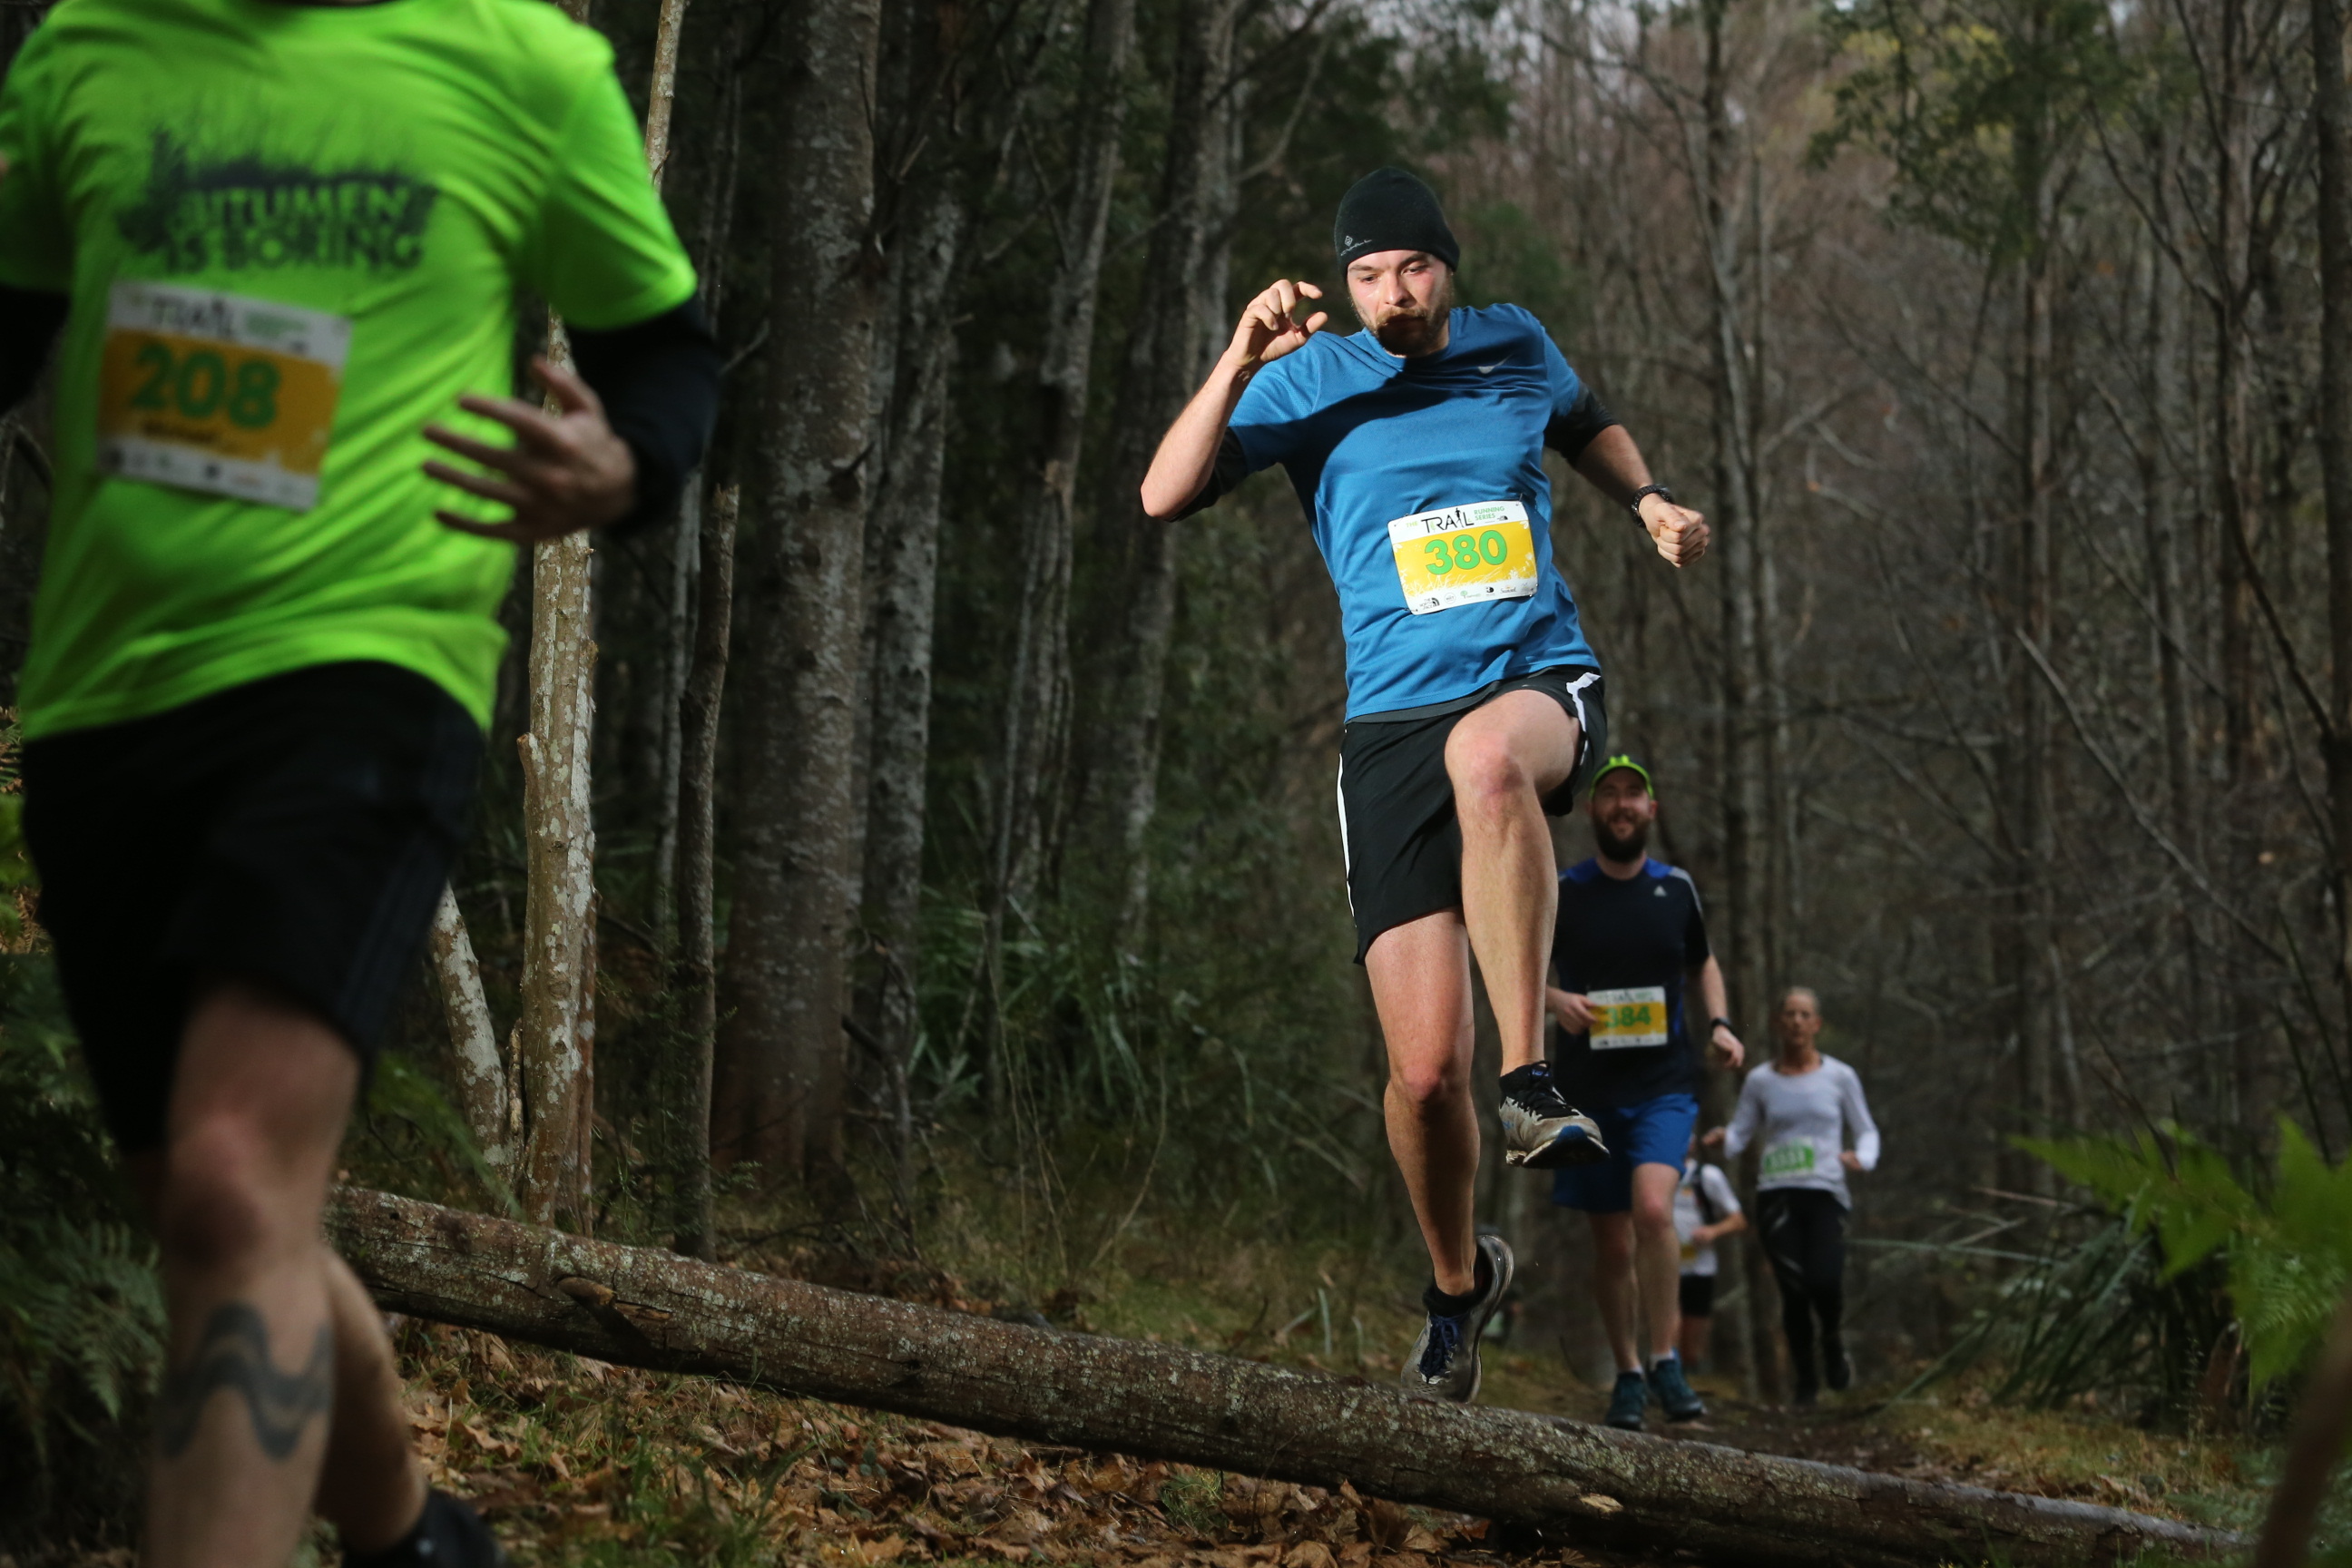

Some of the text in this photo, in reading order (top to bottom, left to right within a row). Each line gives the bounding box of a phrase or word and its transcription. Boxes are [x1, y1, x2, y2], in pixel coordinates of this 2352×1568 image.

[129, 344, 280, 430] 208
[1474, 506, 1505, 515] RUNNING
[1475, 514, 1496, 522] SERIES
[1424, 529, 1508, 576] 380
[1605, 1005, 1651, 1028] 384
